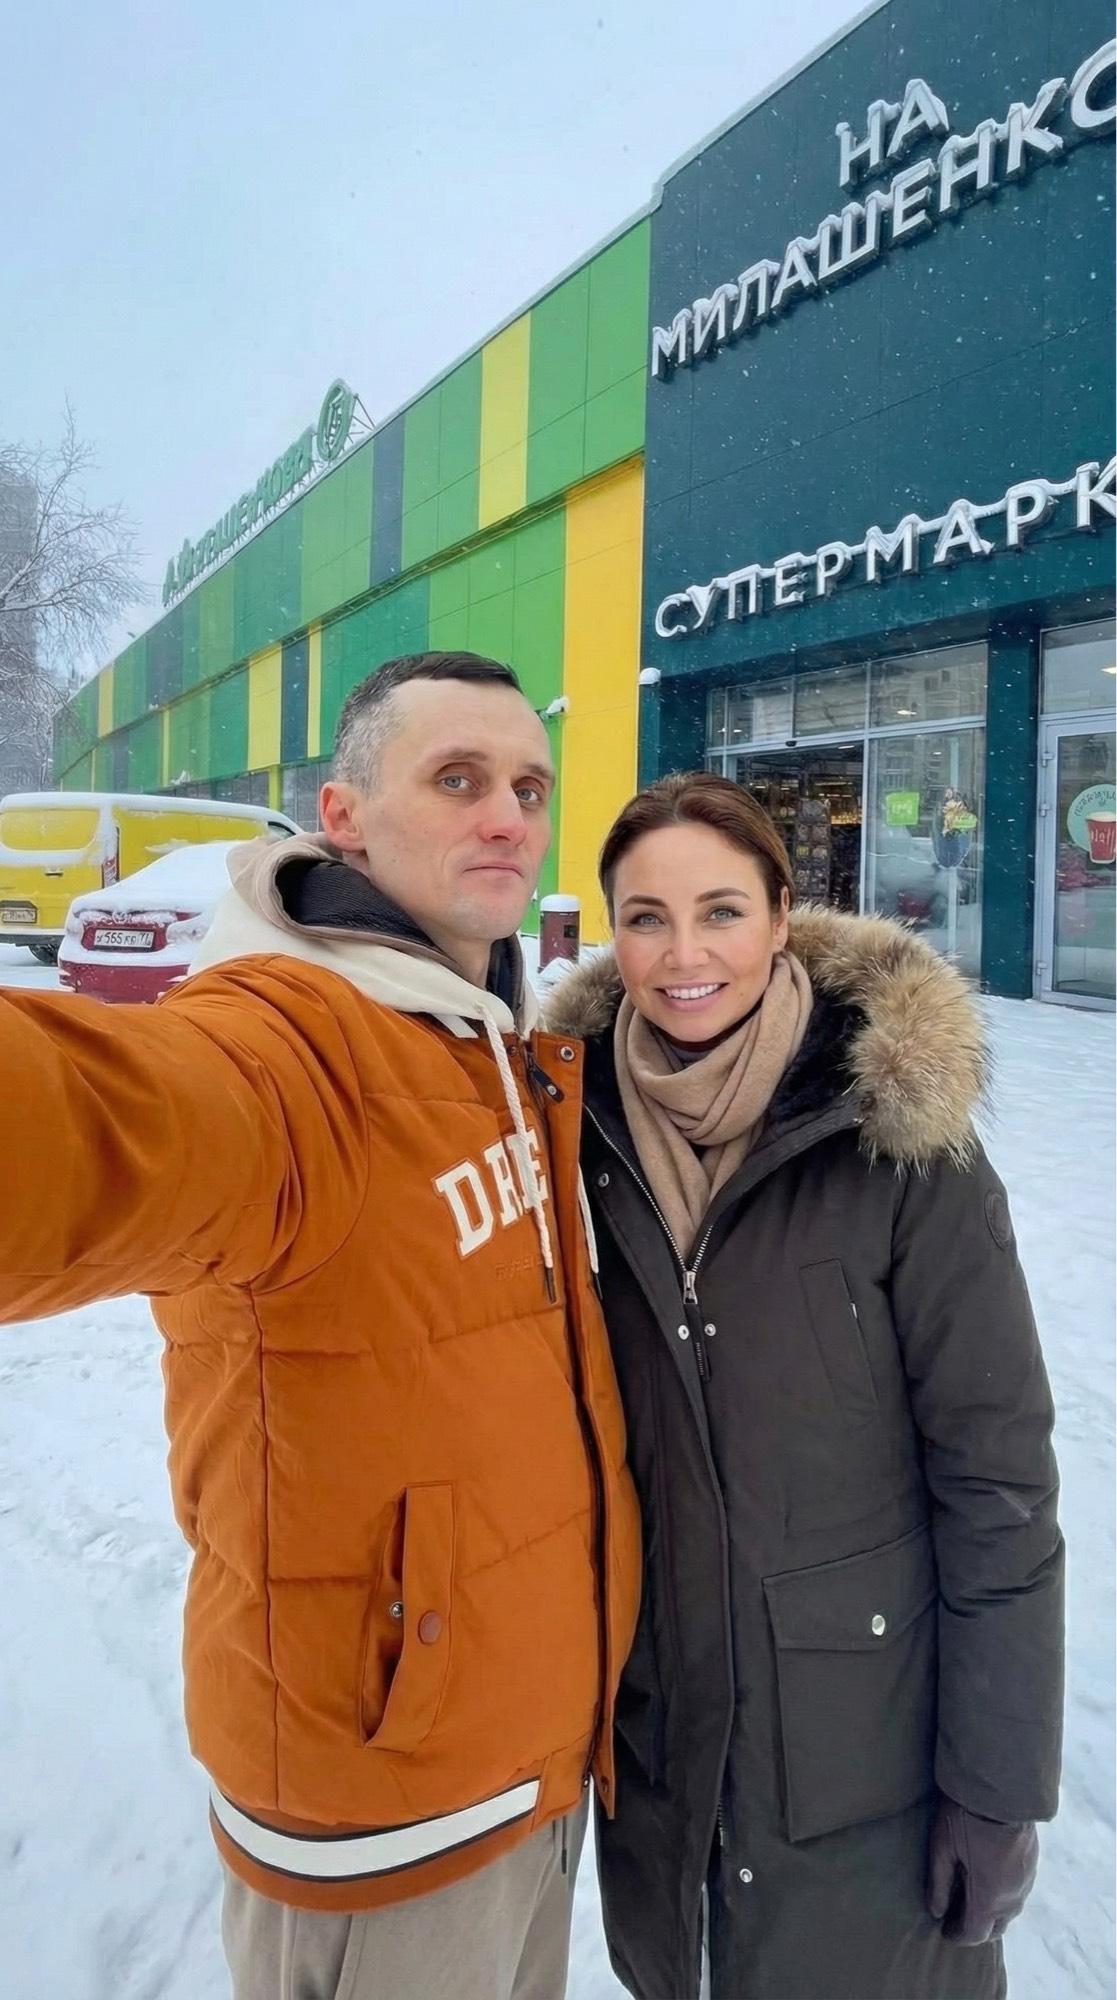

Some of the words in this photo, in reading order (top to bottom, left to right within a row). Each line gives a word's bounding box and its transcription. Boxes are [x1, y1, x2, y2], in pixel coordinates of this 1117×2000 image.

[651, 37, 1117, 379] МИЛАШЕНКО
[836, 79, 950, 192] НА
[655, 455, 1117, 638] СУПЕРМАРК
